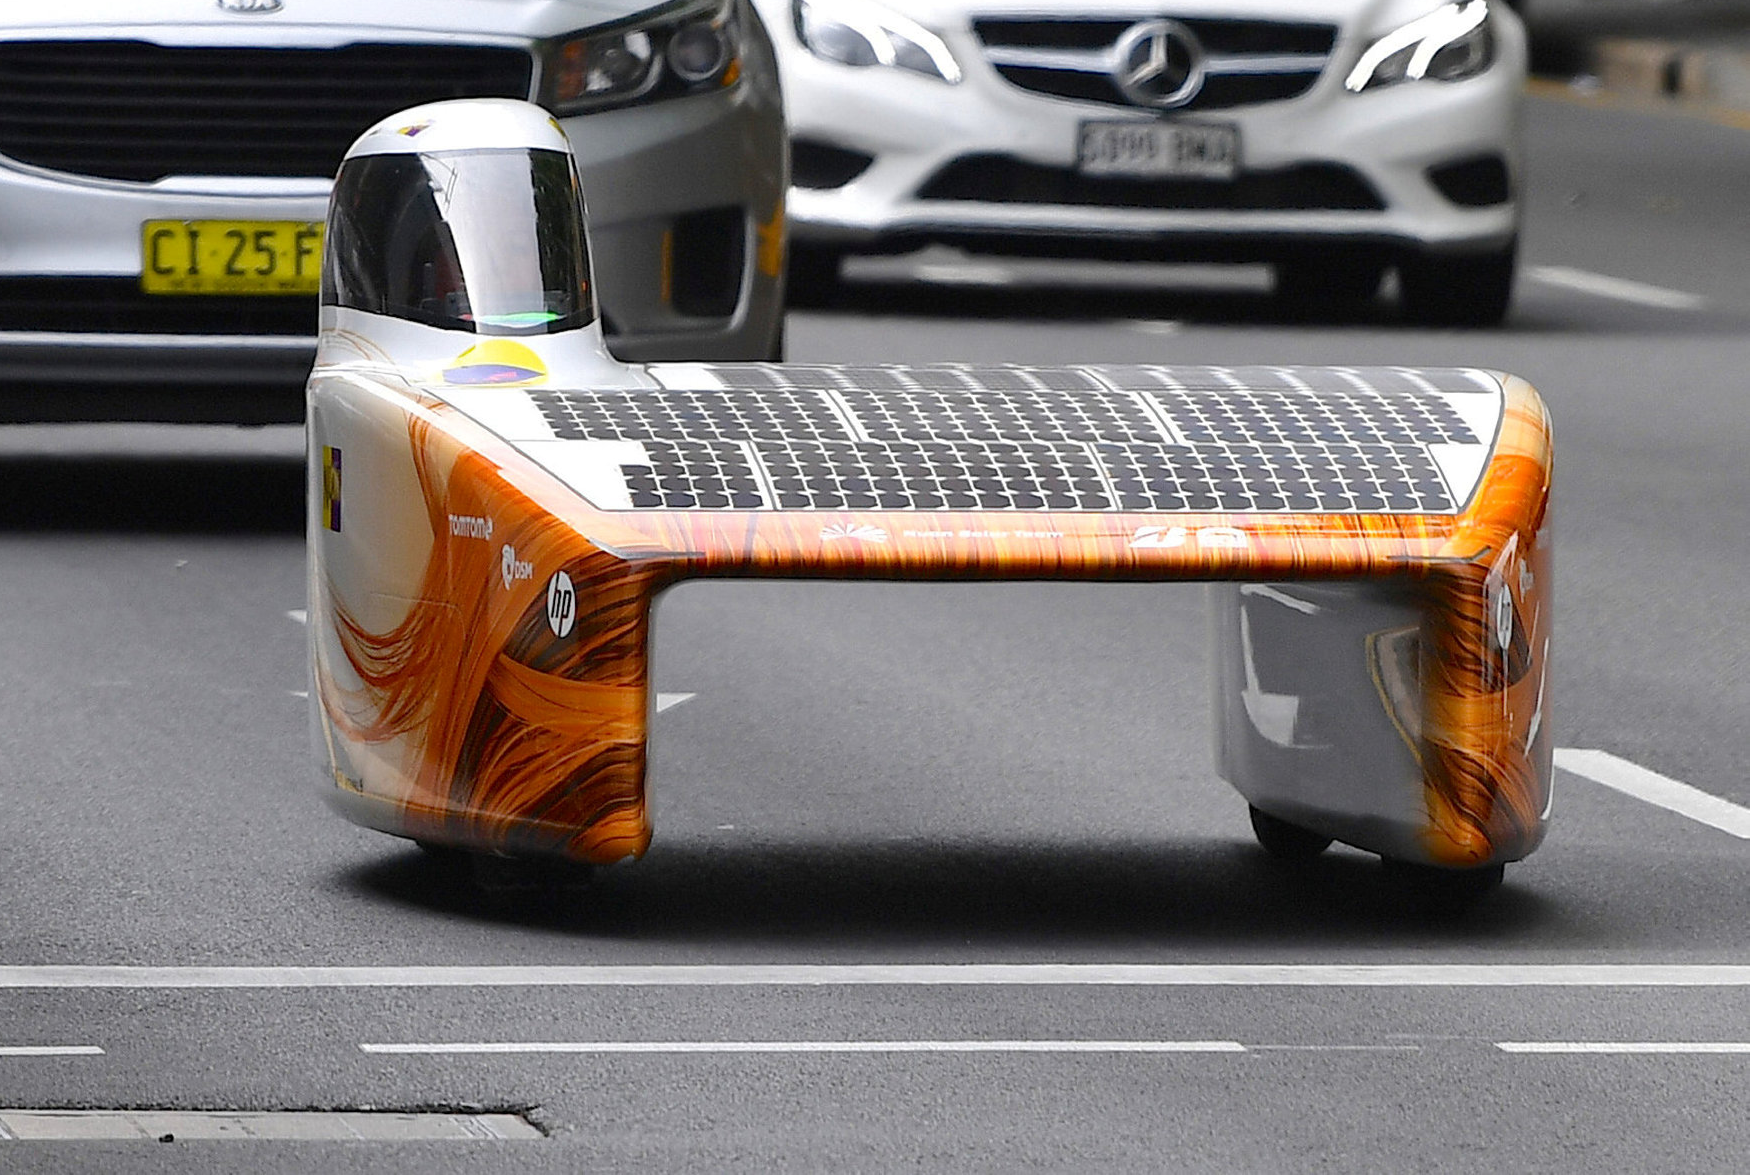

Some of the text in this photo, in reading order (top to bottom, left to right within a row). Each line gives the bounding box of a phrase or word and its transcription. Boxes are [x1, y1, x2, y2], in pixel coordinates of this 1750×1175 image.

[295, 228, 322, 275] F
[514, 560, 533, 580] DSM
[550, 571, 572, 637] hp
